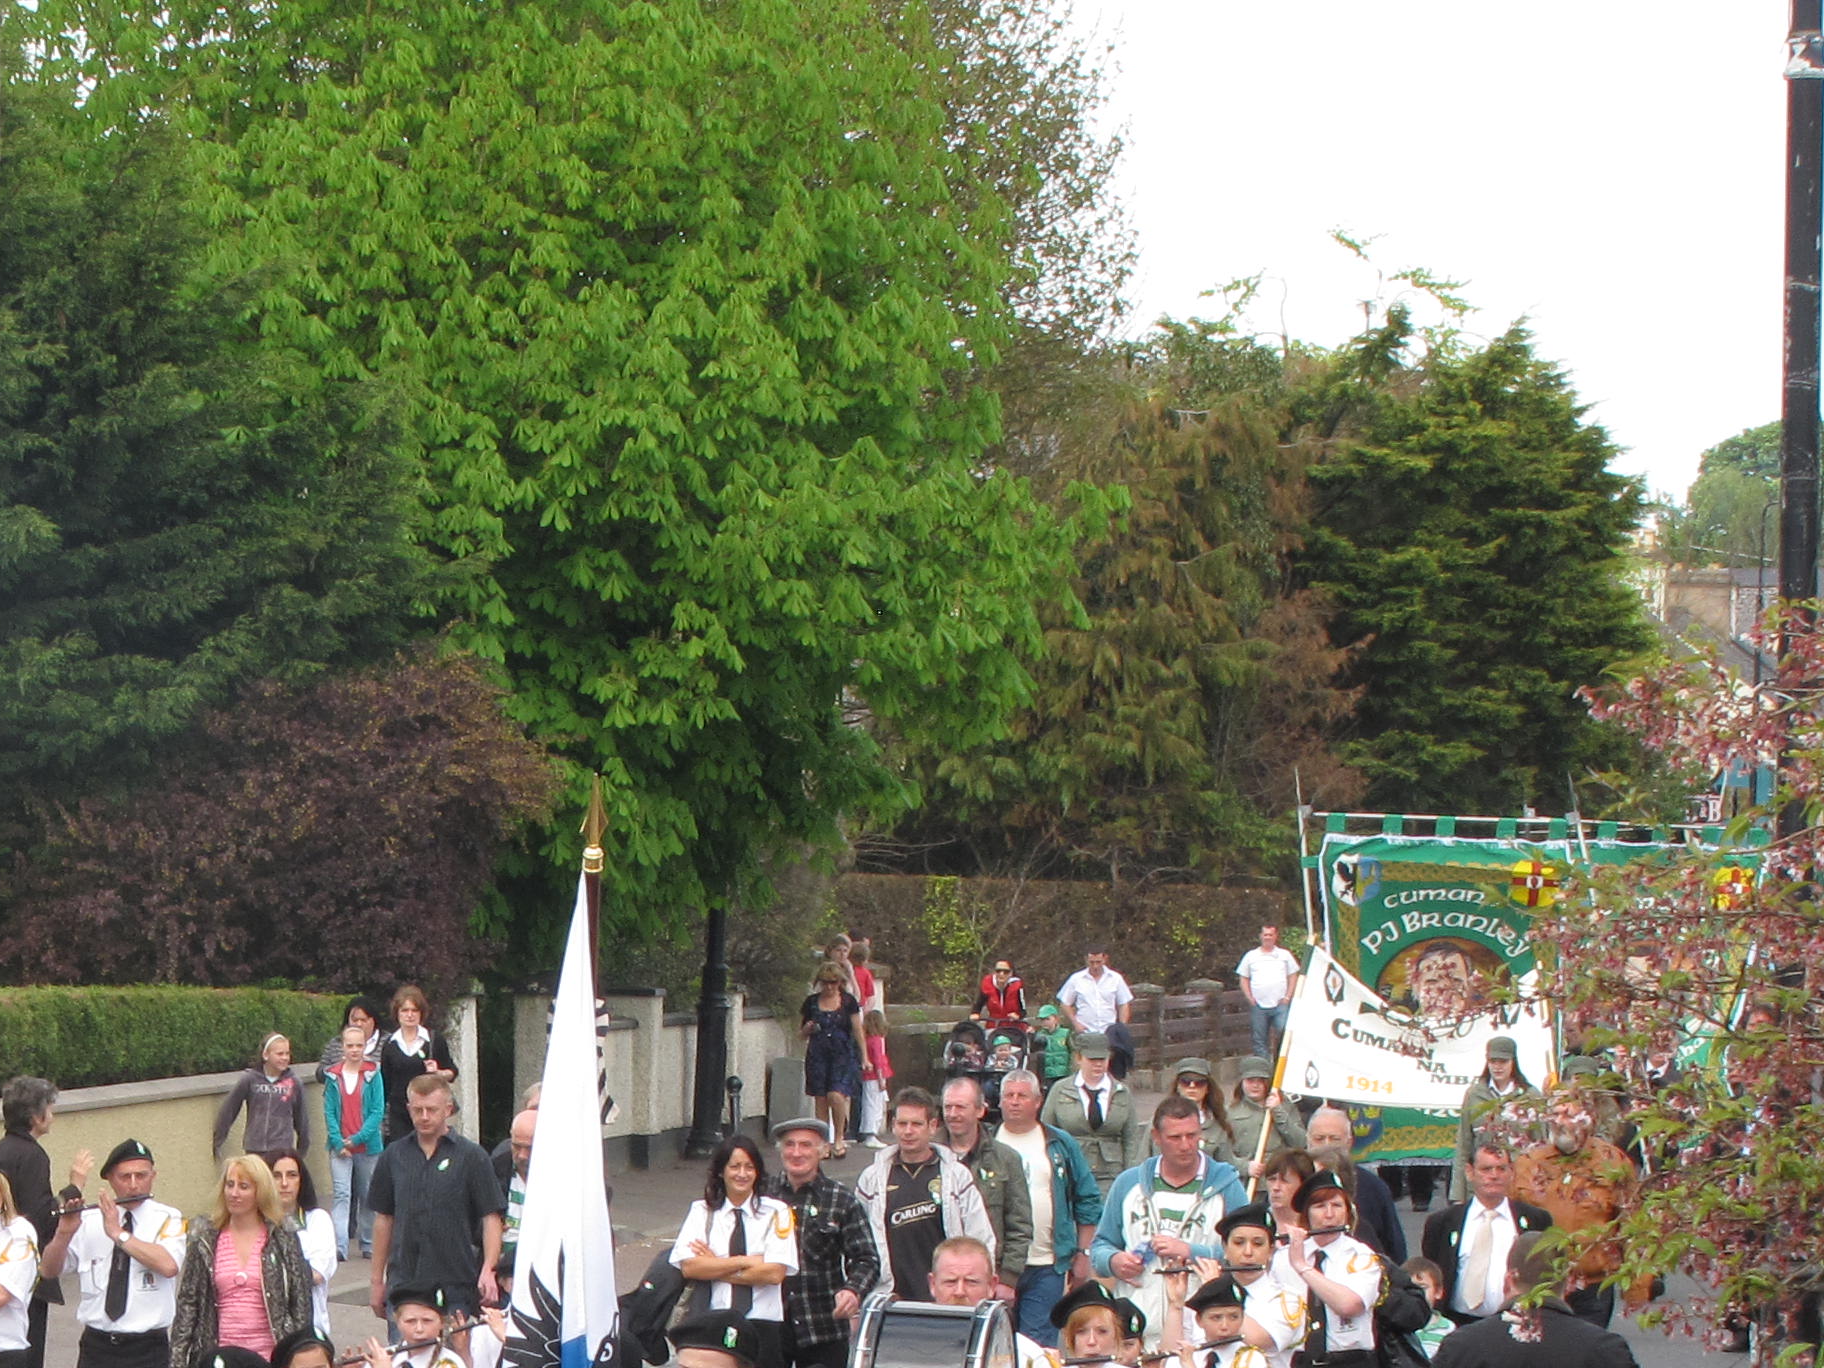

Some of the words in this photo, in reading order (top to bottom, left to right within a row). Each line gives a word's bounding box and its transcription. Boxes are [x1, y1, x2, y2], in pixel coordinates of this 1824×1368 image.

[1360, 920, 1400, 955] PJ
[1416, 1058, 1447, 1073] NA
[1345, 1075, 1393, 1094] 1914
[891, 1203, 936, 1225] CARLING
